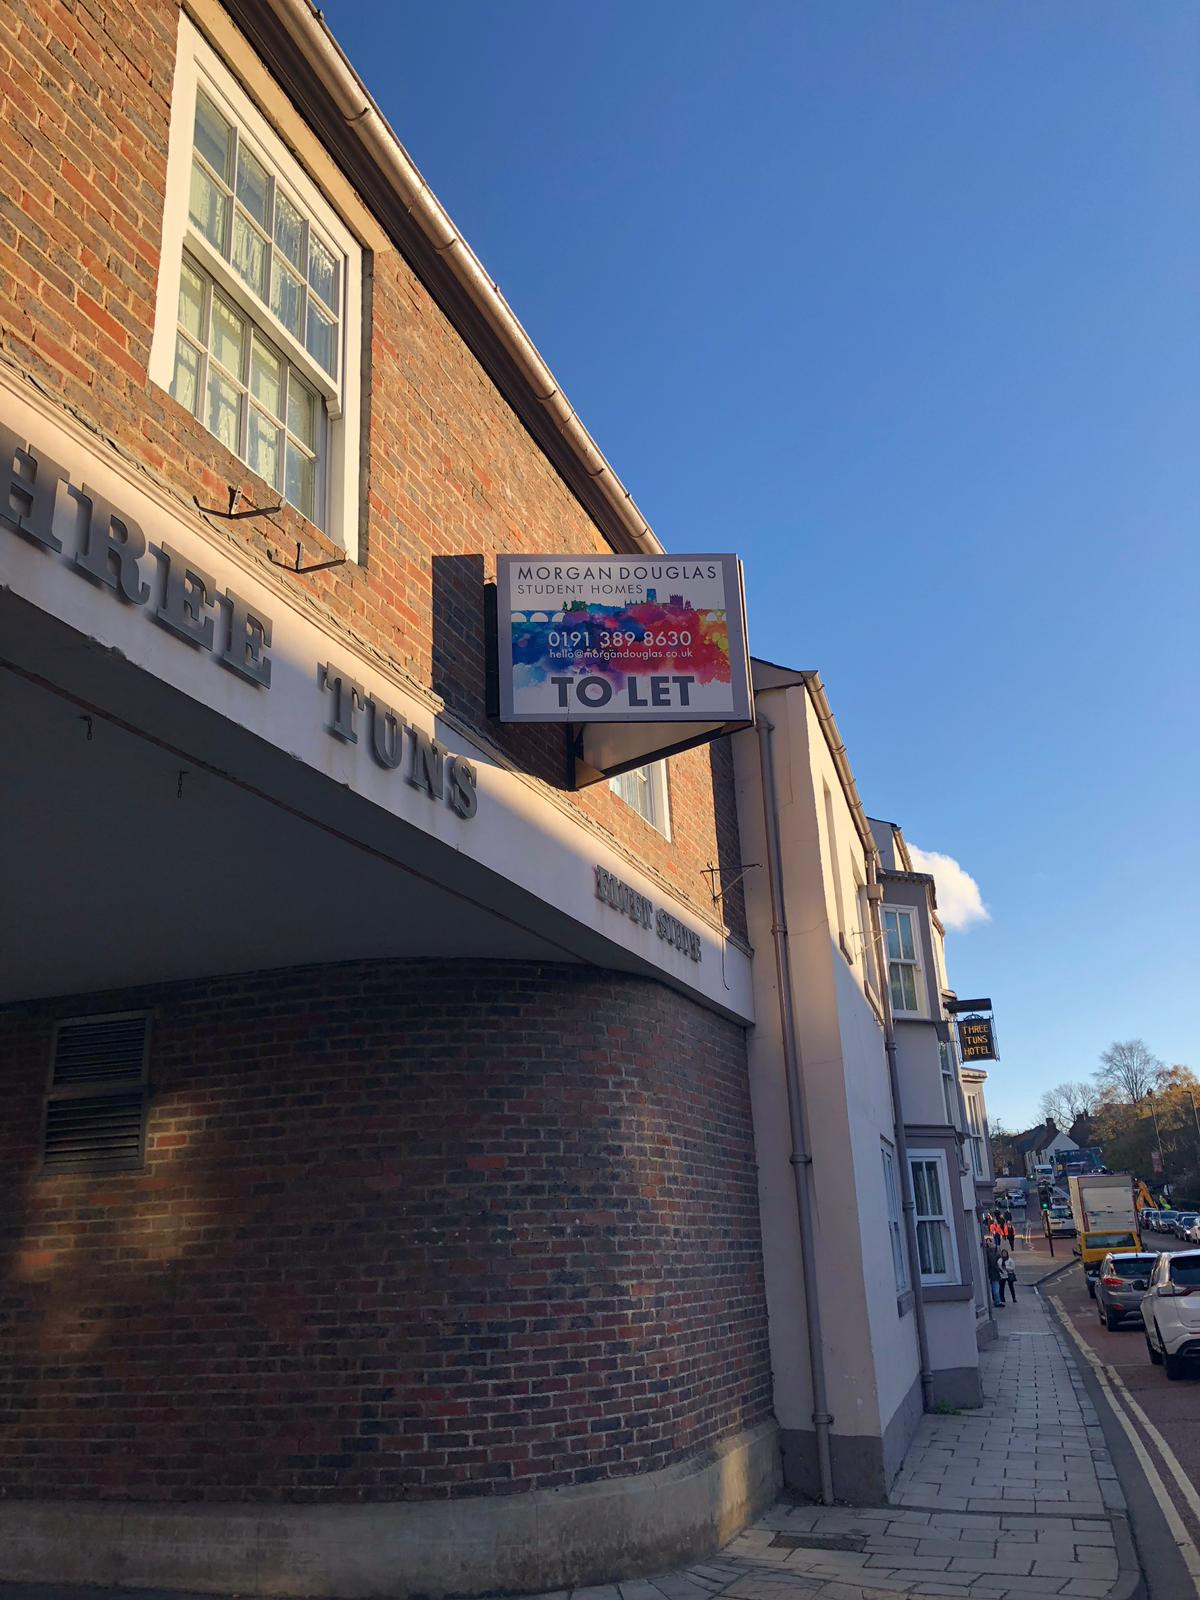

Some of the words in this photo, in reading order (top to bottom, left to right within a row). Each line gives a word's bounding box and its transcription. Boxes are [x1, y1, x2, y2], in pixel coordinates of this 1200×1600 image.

[518, 566, 612, 580] MORGAN
[620, 565, 717, 580] DOUGLAS
[517, 584, 584, 595] STUDENT
[591, 584, 643, 594] HOMES
[548, 631, 590, 647] 0191
[600, 631, 636, 647] 389
[643, 631, 692, 647] 8630
[549, 647, 693, 661] hello@morgandouglas.co.uk
[551, 676, 613, 708] TO
[627, 675, 695, 706] LET
[317, 661, 478, 819] TUNS
[962, 1024, 989, 1034] THREE
[965, 1035, 988, 1045] TUNS
[964, 1046, 991, 1056] HOTEL
